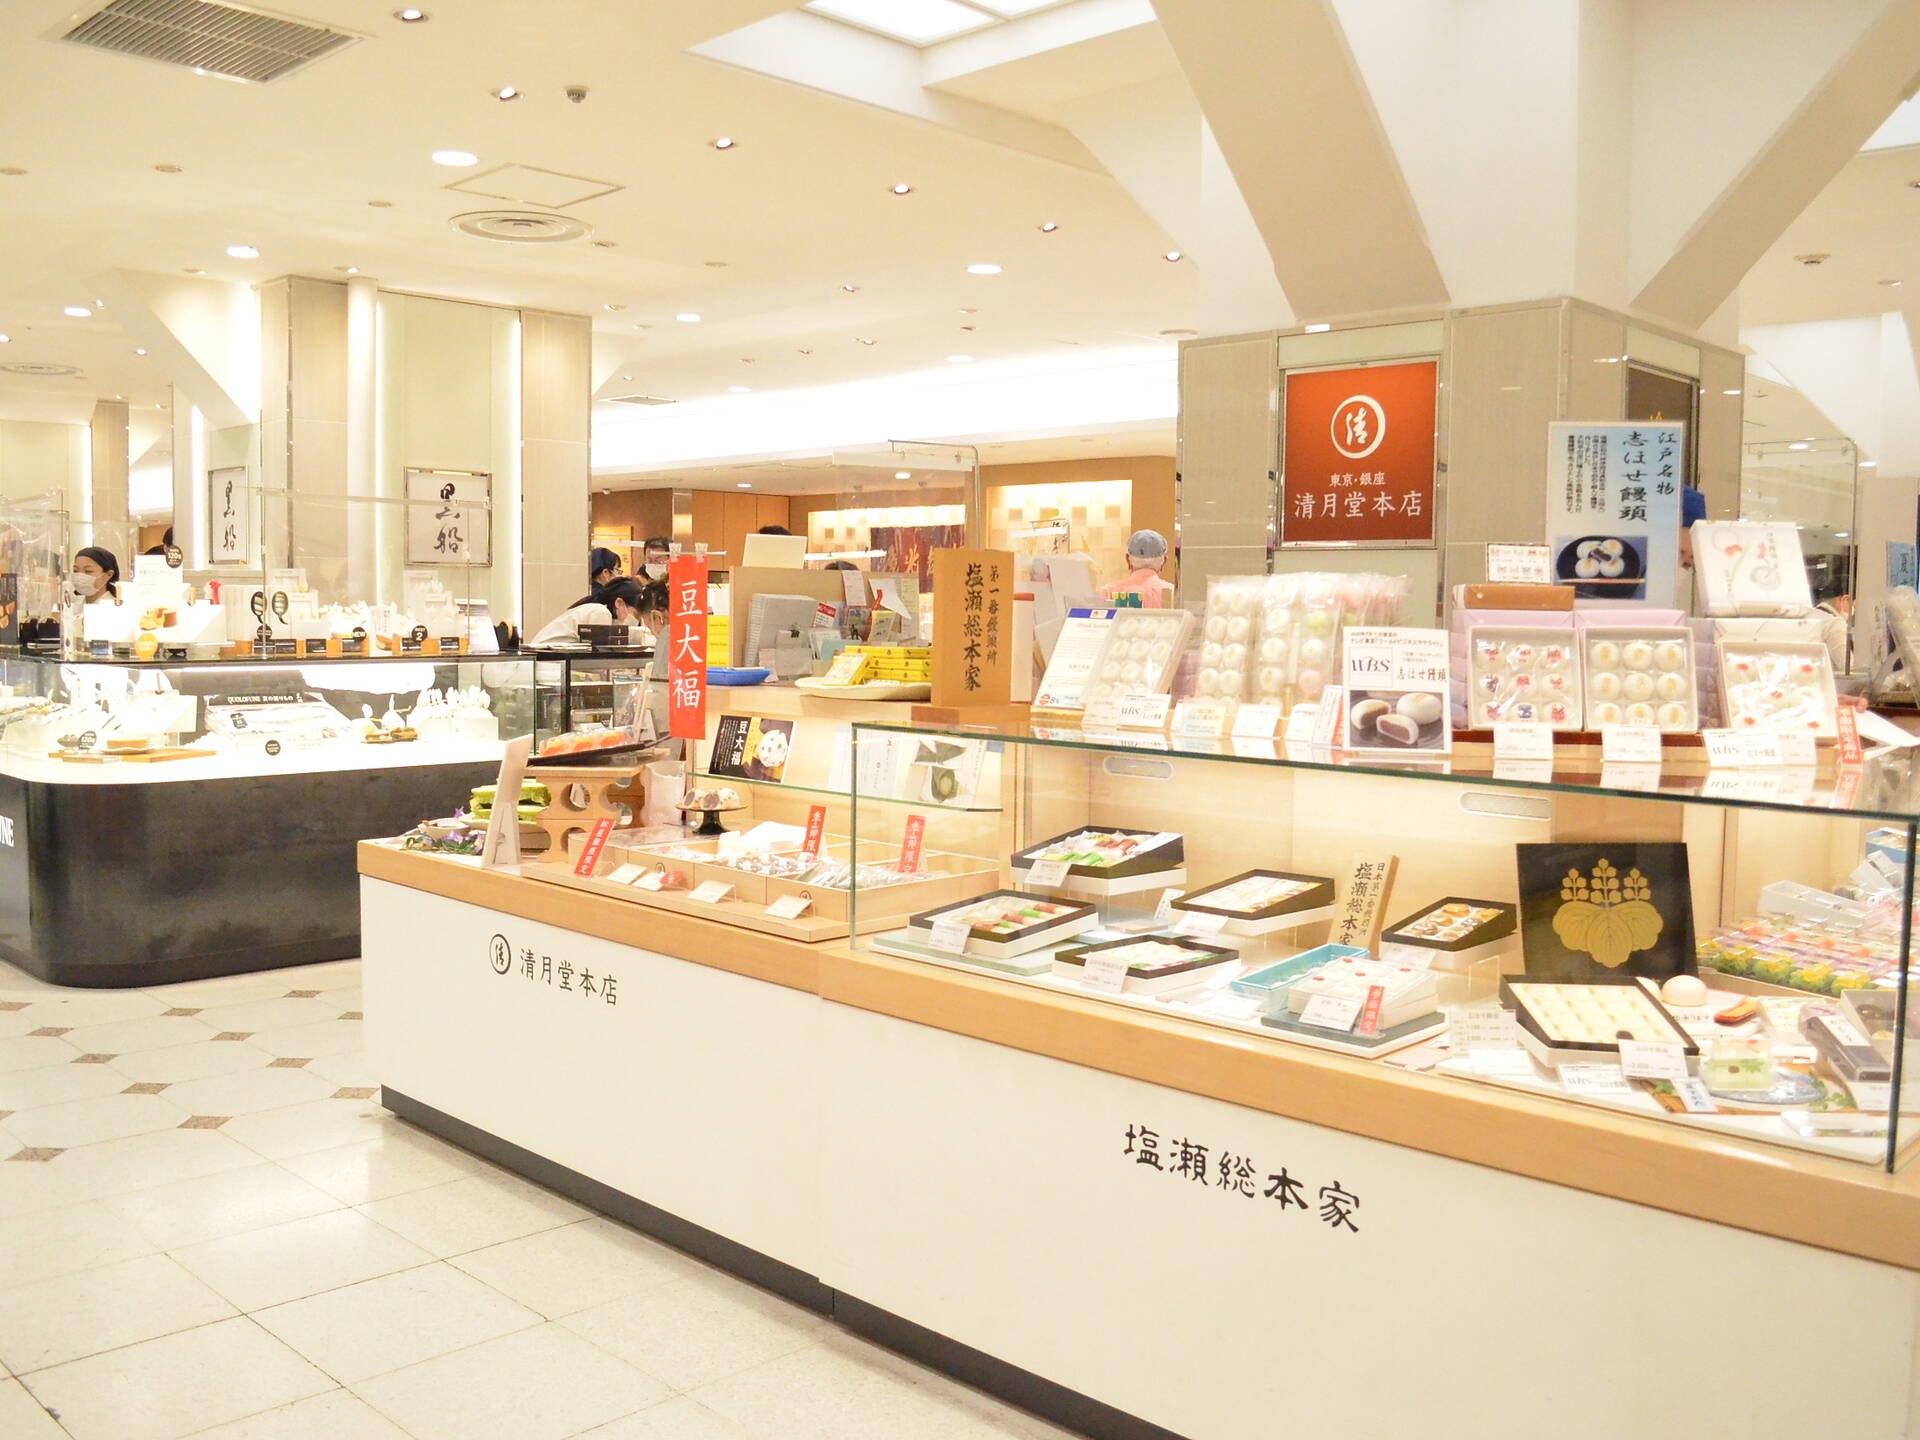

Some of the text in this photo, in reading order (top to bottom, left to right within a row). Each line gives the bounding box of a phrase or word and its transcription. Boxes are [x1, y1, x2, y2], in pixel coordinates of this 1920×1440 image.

[1329, 472, 1386, 487] 東京・銀座
[1618, 431, 1648, 521] 志ほせ饅頭
[1656, 432, 1677, 495] 江戸名物
[1294, 490, 1422, 520] 清月堂本店
[672, 581, 702, 708] 豆大福
[964, 562, 984, 691] 塩瀬総本家
[1352, 659, 1391, 672] WBS
[731, 721, 748, 765] 豆大福
[807, 811, 822, 851] 季節限
[520, 948, 617, 1006] 清月堂本店
[1124, 1123, 1360, 1233] 塩瀬総本家
